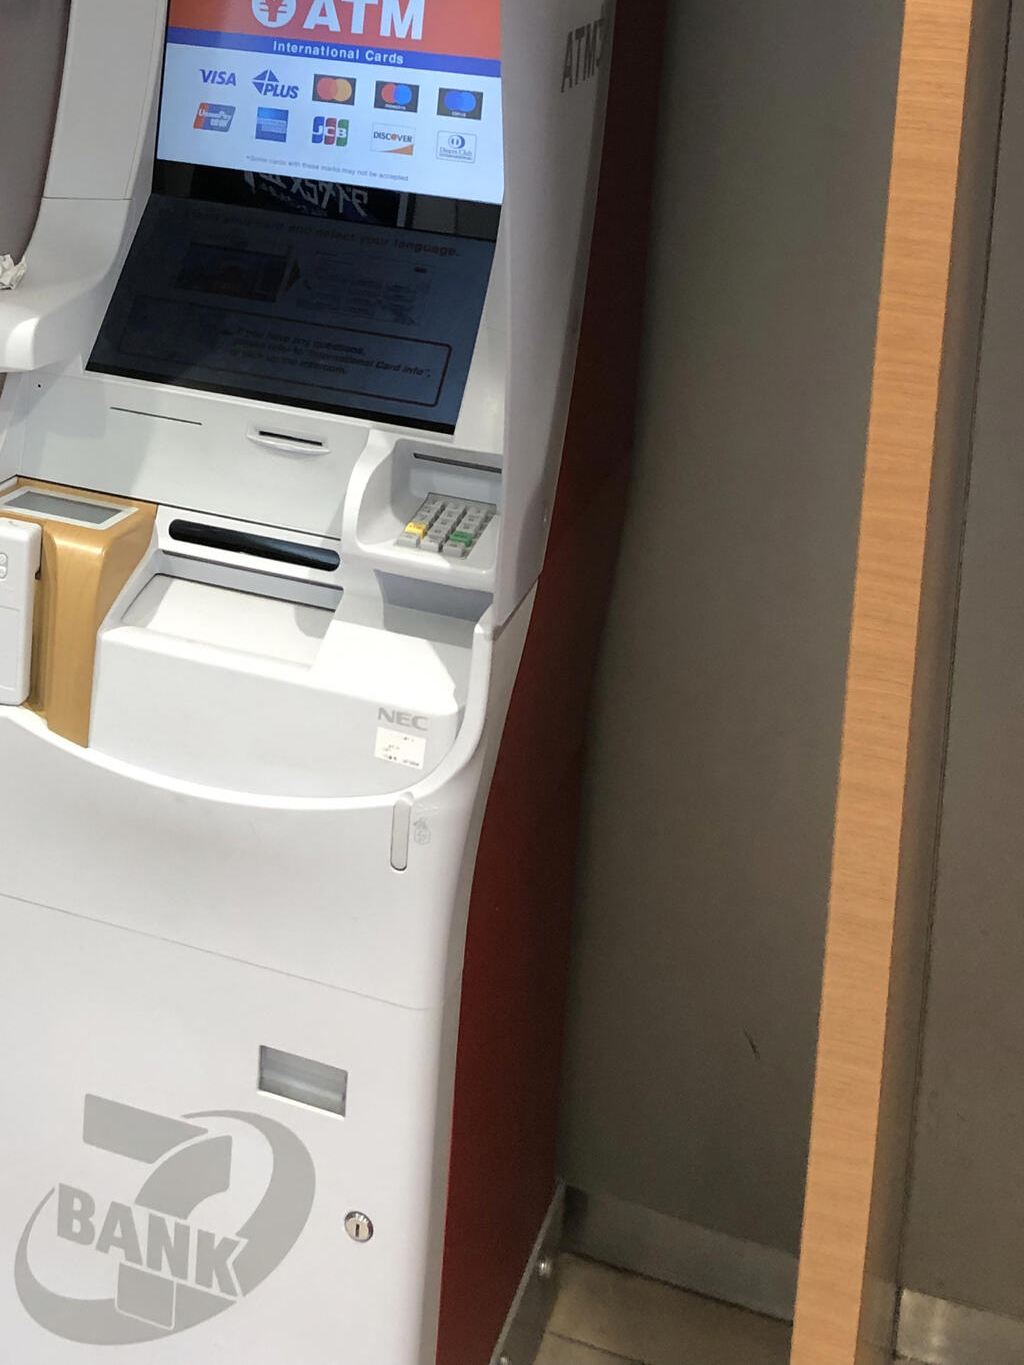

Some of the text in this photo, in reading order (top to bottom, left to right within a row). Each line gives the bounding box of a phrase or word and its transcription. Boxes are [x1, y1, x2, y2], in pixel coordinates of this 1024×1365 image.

[273, 40, 404, 65] International Cards
[199, 68, 237, 86] VISA
[262, 81, 299, 100] PLUS
[317, 125, 347, 140] JCB
[373, 131, 412, 143] DISCOVER
[377, 707, 429, 731] NEC
[56, 1182, 249, 1297] BANK
